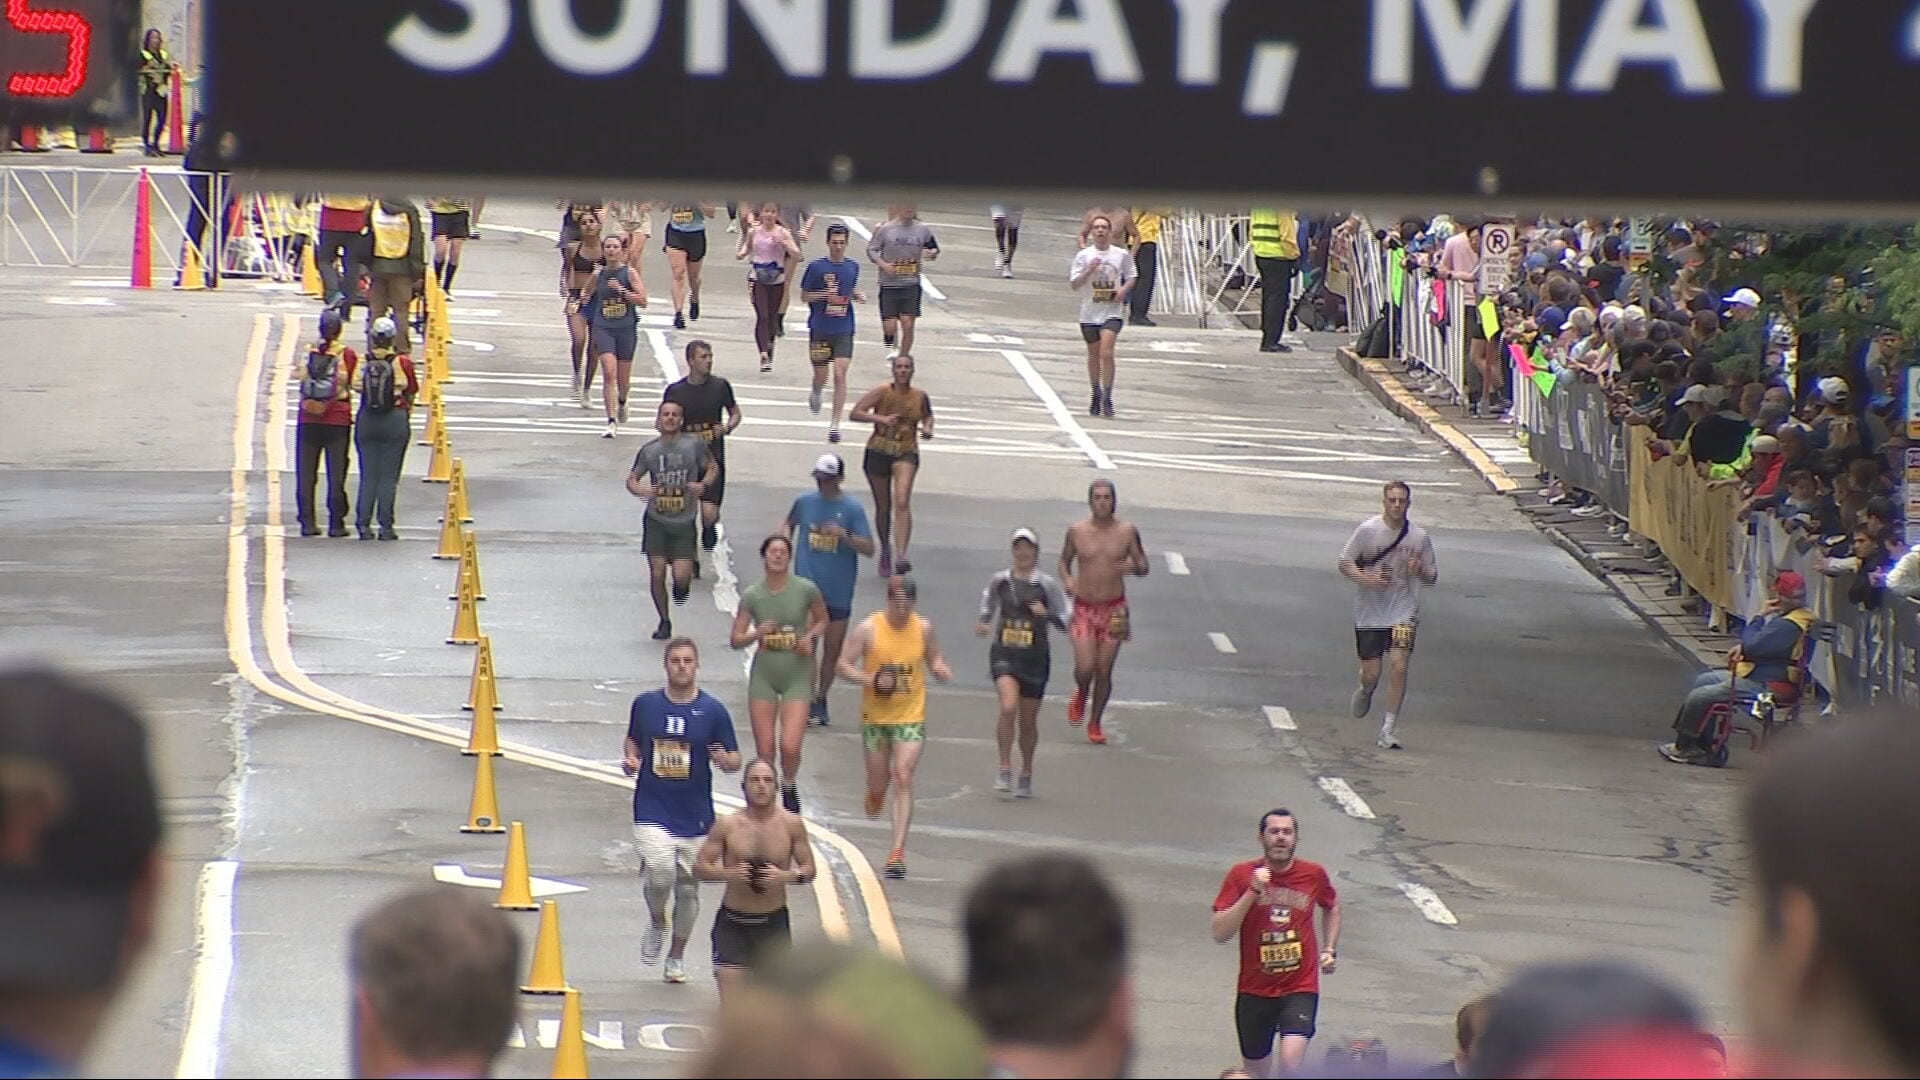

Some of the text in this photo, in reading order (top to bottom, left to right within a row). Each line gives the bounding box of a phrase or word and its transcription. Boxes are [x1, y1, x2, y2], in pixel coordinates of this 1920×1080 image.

[386, 0, 1298, 116] SUNDAY,
[1368, 0, 1818, 95] MAY
[462, 583, 470, 611] P3R
[479, 646, 487, 675] P3R
